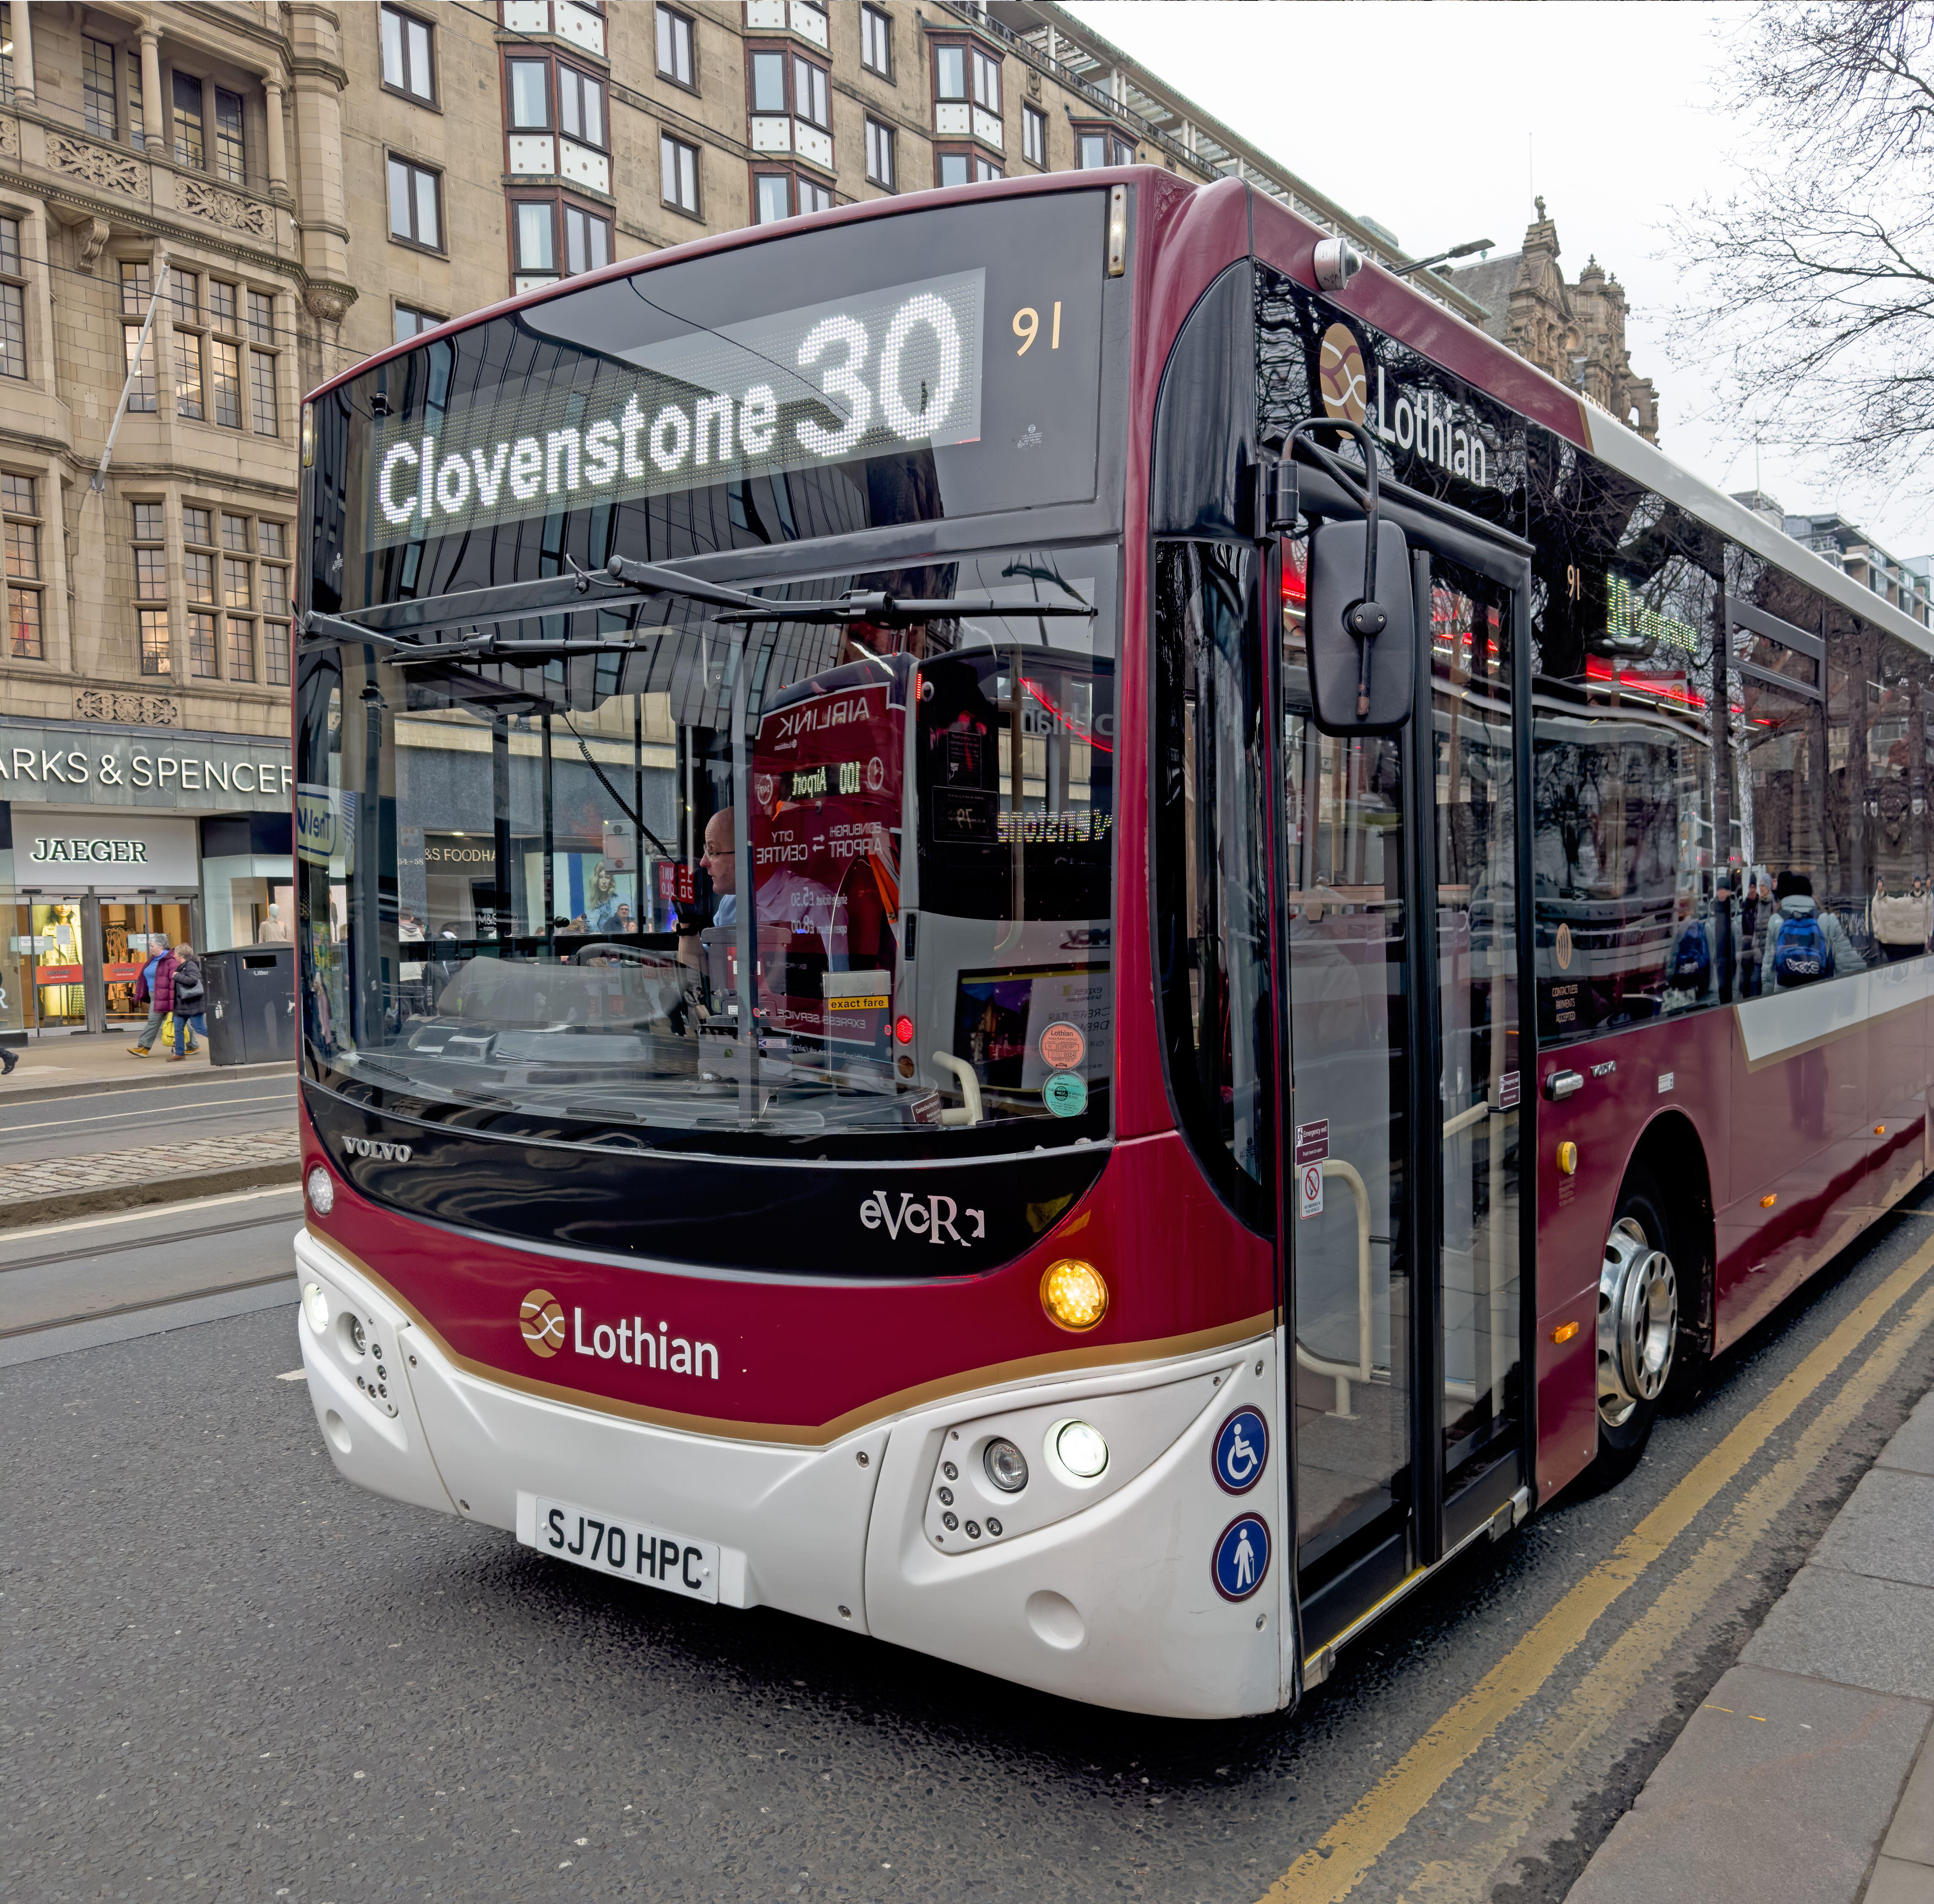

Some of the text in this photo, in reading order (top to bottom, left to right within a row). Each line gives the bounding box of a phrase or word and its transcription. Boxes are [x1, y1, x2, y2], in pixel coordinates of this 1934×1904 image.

[1012, 301, 1061, 356] 91
[378, 293, 961, 524] Clovenstone 30
[1378, 366, 1486, 486] Lothian
[1567, 564, 1580, 601] 91
[100, 754, 123, 785] &
[31, 838, 147, 863] JAEGER
[831, 998, 884, 1009] exact fare
[1552, 985, 1579, 997] CONTACTLESS
[1556, 998, 1575, 1009] PAYMENTS
[1556, 1011, 1575, 1023] ACCEPTED
[1303, 1128, 1321, 1137] Emergency
[342, 1136, 412, 1163] VOLVO
[574, 1308, 719, 1380] Lothian
[549, 1508, 703, 1589] SJ70 HPC
